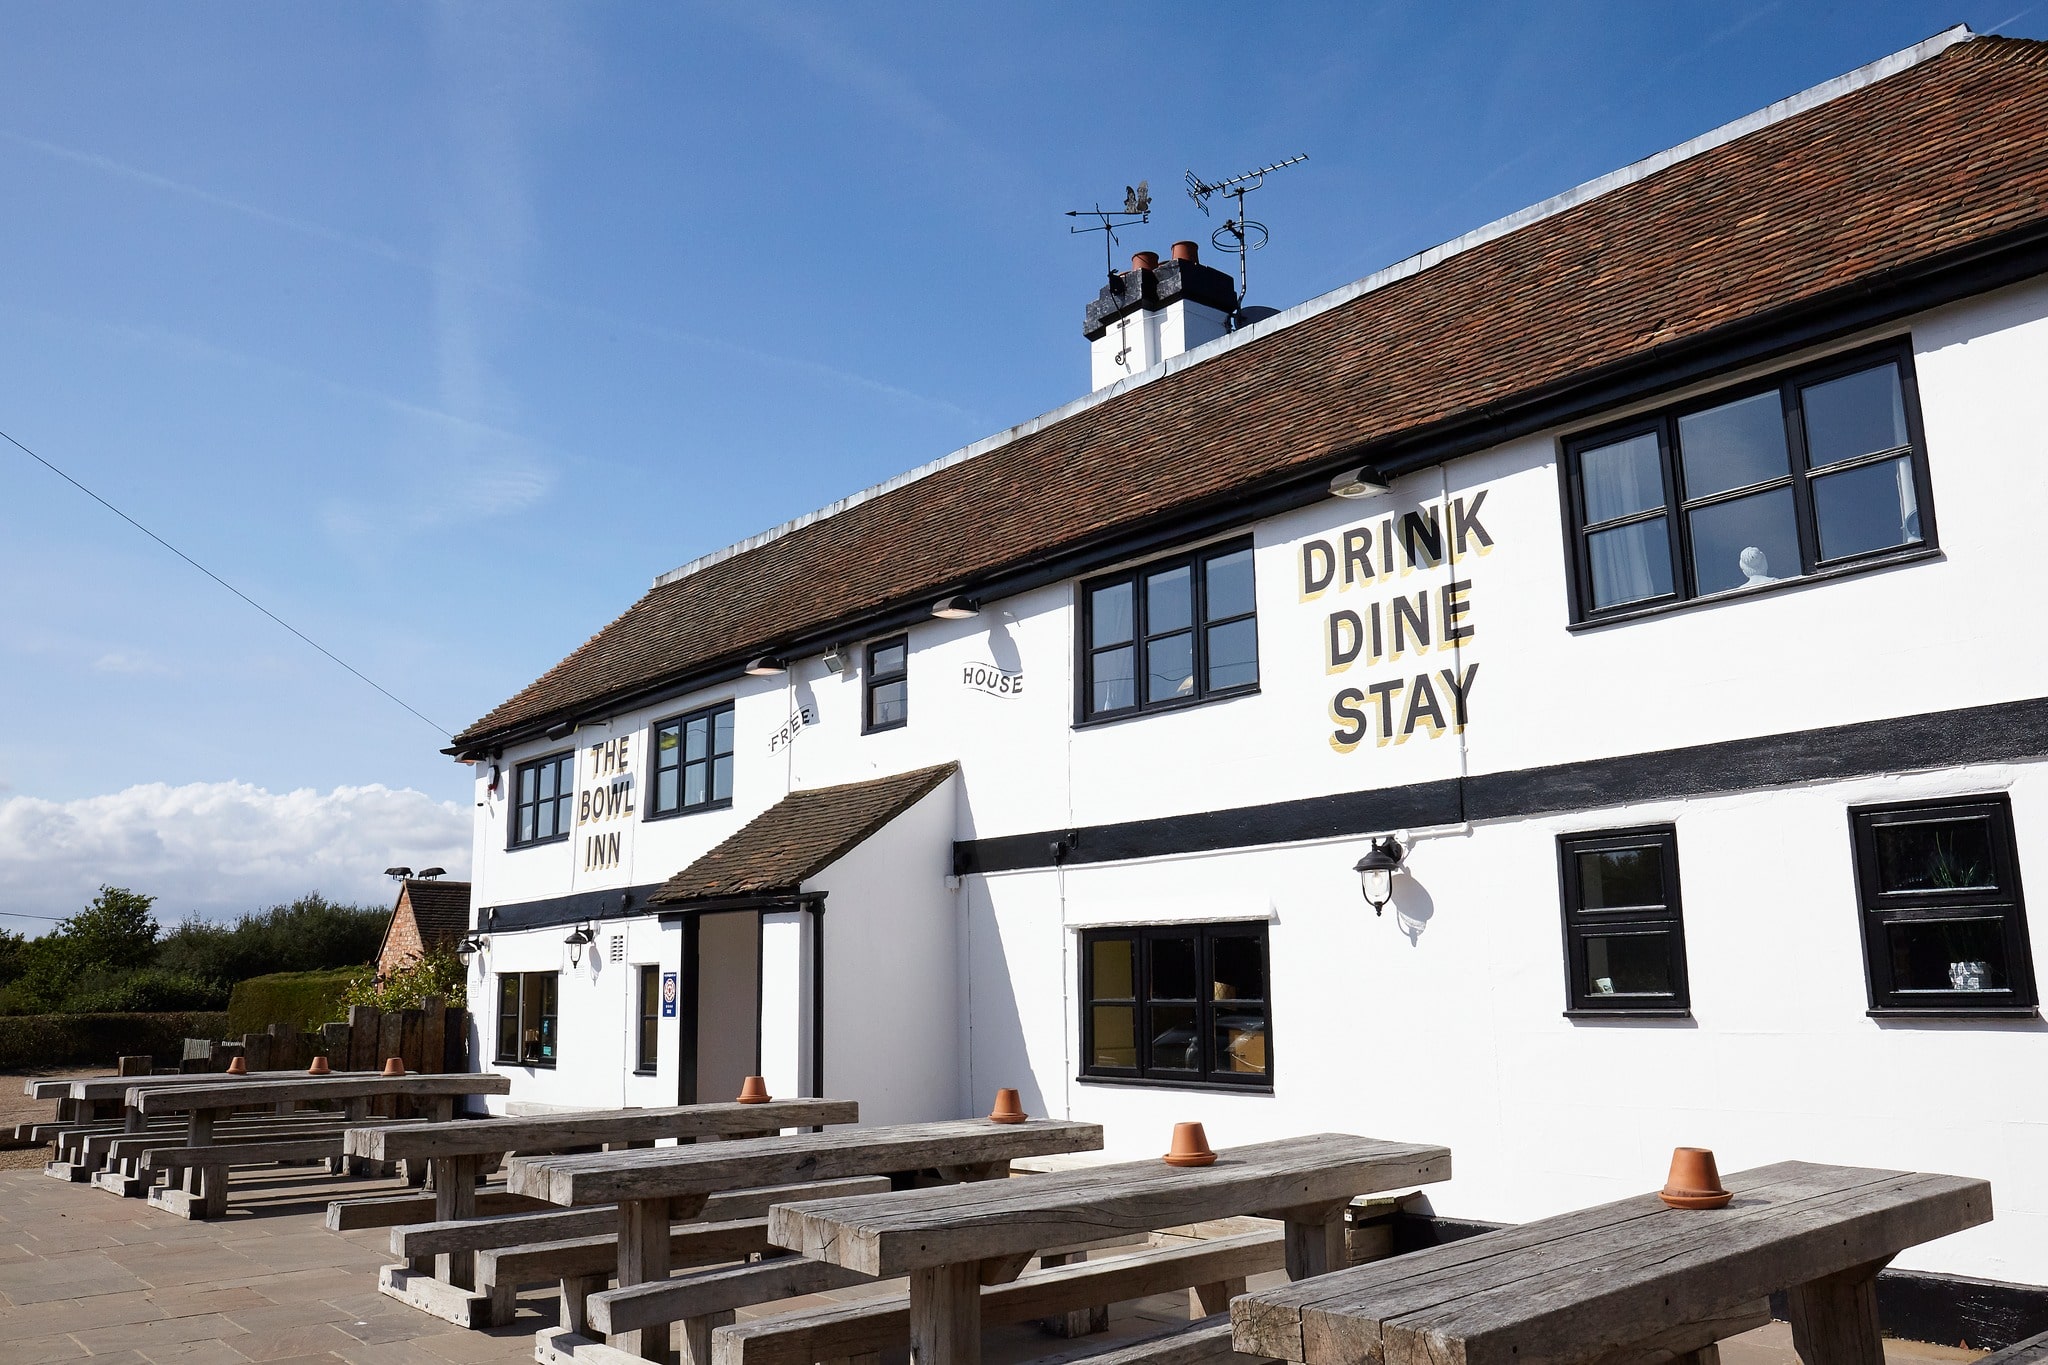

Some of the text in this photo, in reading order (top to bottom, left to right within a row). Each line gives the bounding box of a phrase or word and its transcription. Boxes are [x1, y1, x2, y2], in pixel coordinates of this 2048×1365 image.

[1299, 489, 1495, 604] DRINK
[1324, 579, 1475, 675] DINE
[963, 667, 1024, 694] HOUSE
[771, 708, 811, 752] FREE
[1328, 663, 1480, 753] STAY
[590, 736, 630, 779] THE
[578, 780, 634, 826] BOWL
[585, 831, 621, 872] INN
